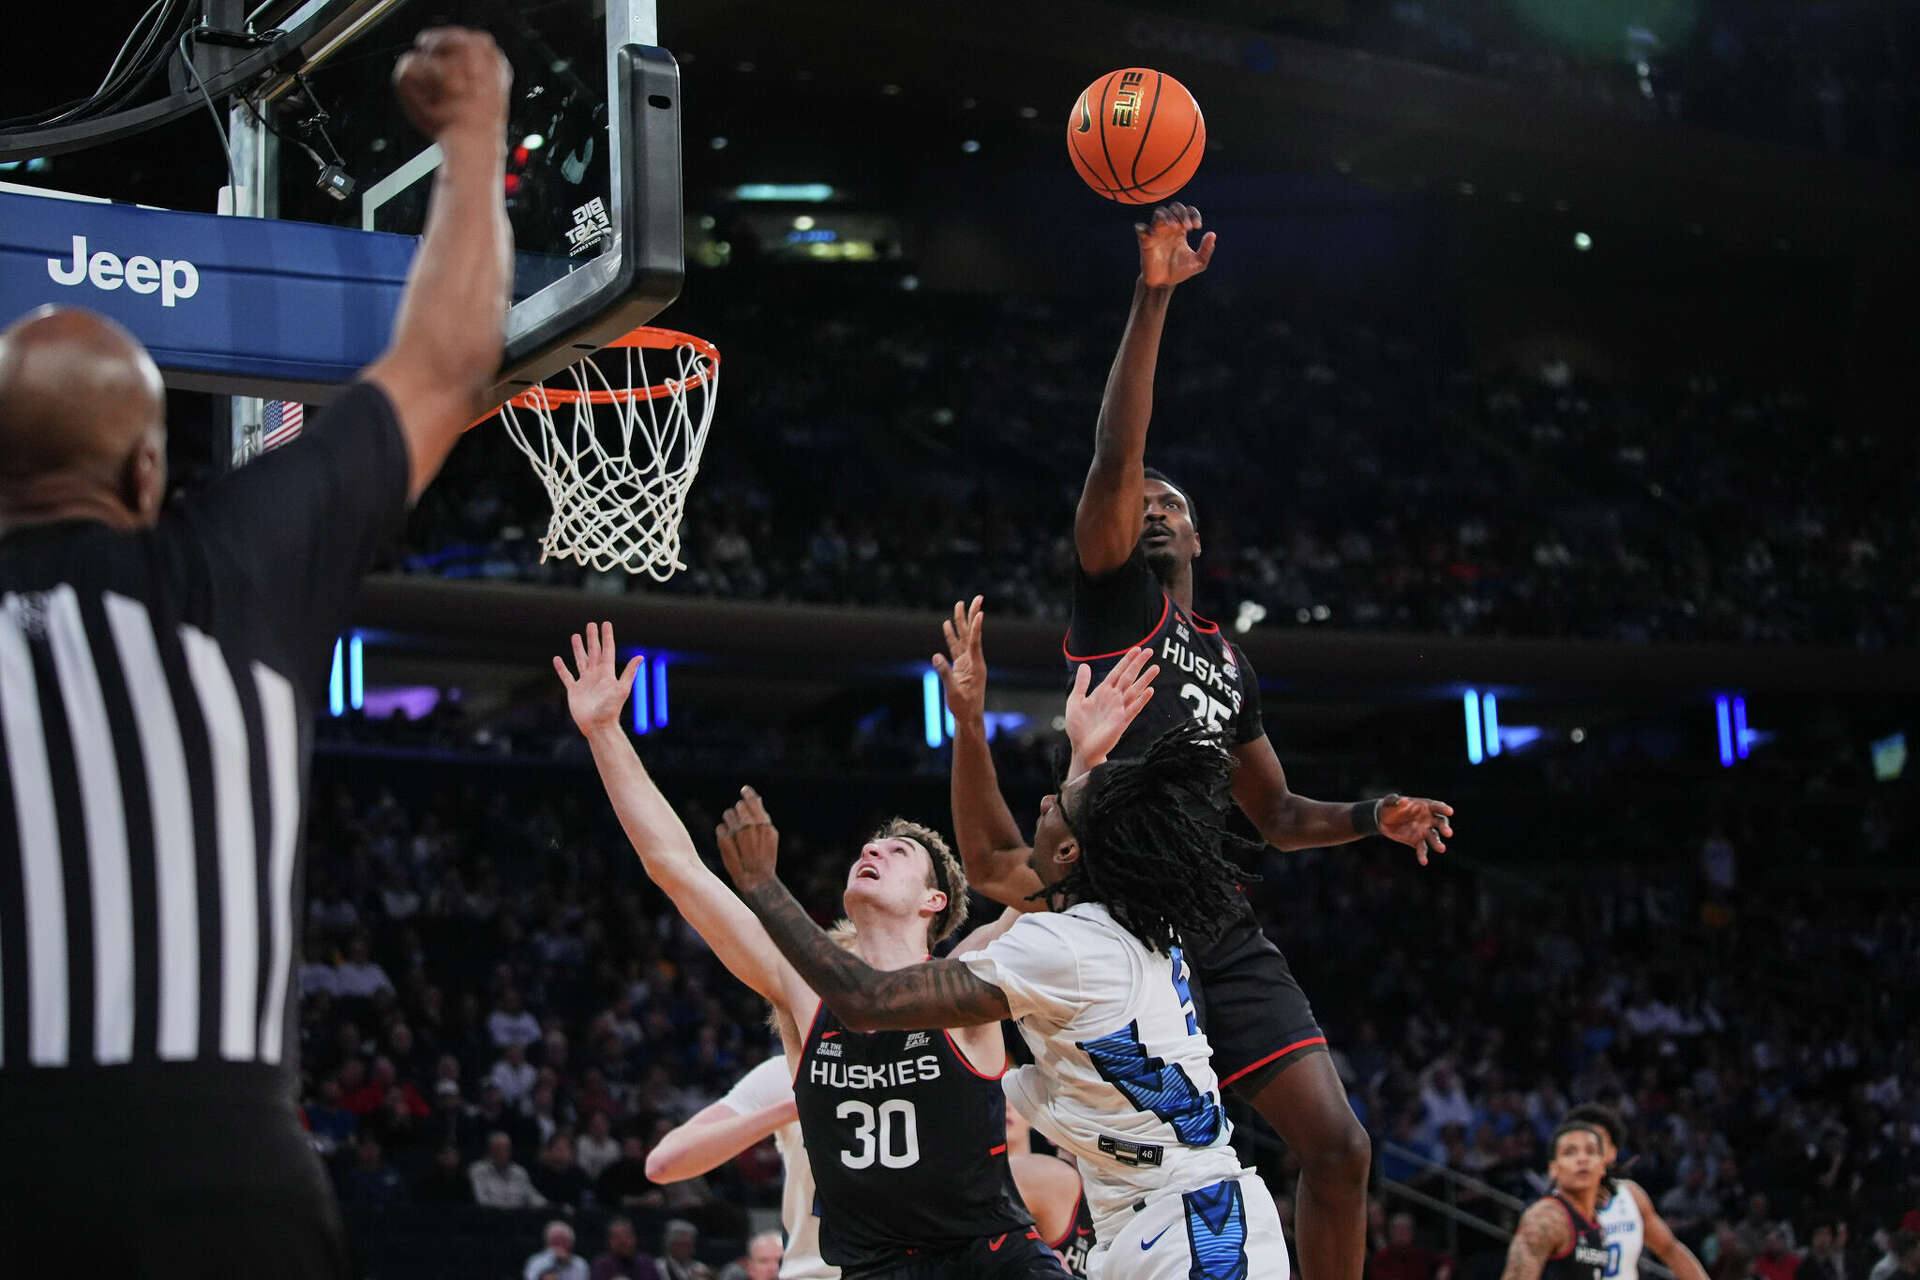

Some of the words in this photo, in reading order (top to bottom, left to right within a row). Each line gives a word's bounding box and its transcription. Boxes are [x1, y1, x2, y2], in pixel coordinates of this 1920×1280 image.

[1112, 72, 1143, 127] ELITE
[47, 234, 200, 307] Jeep
[810, 1055, 941, 1090] HUSKIES
[836, 1098, 920, 1170] 30
[1142, 1149, 1153, 1160] 46
